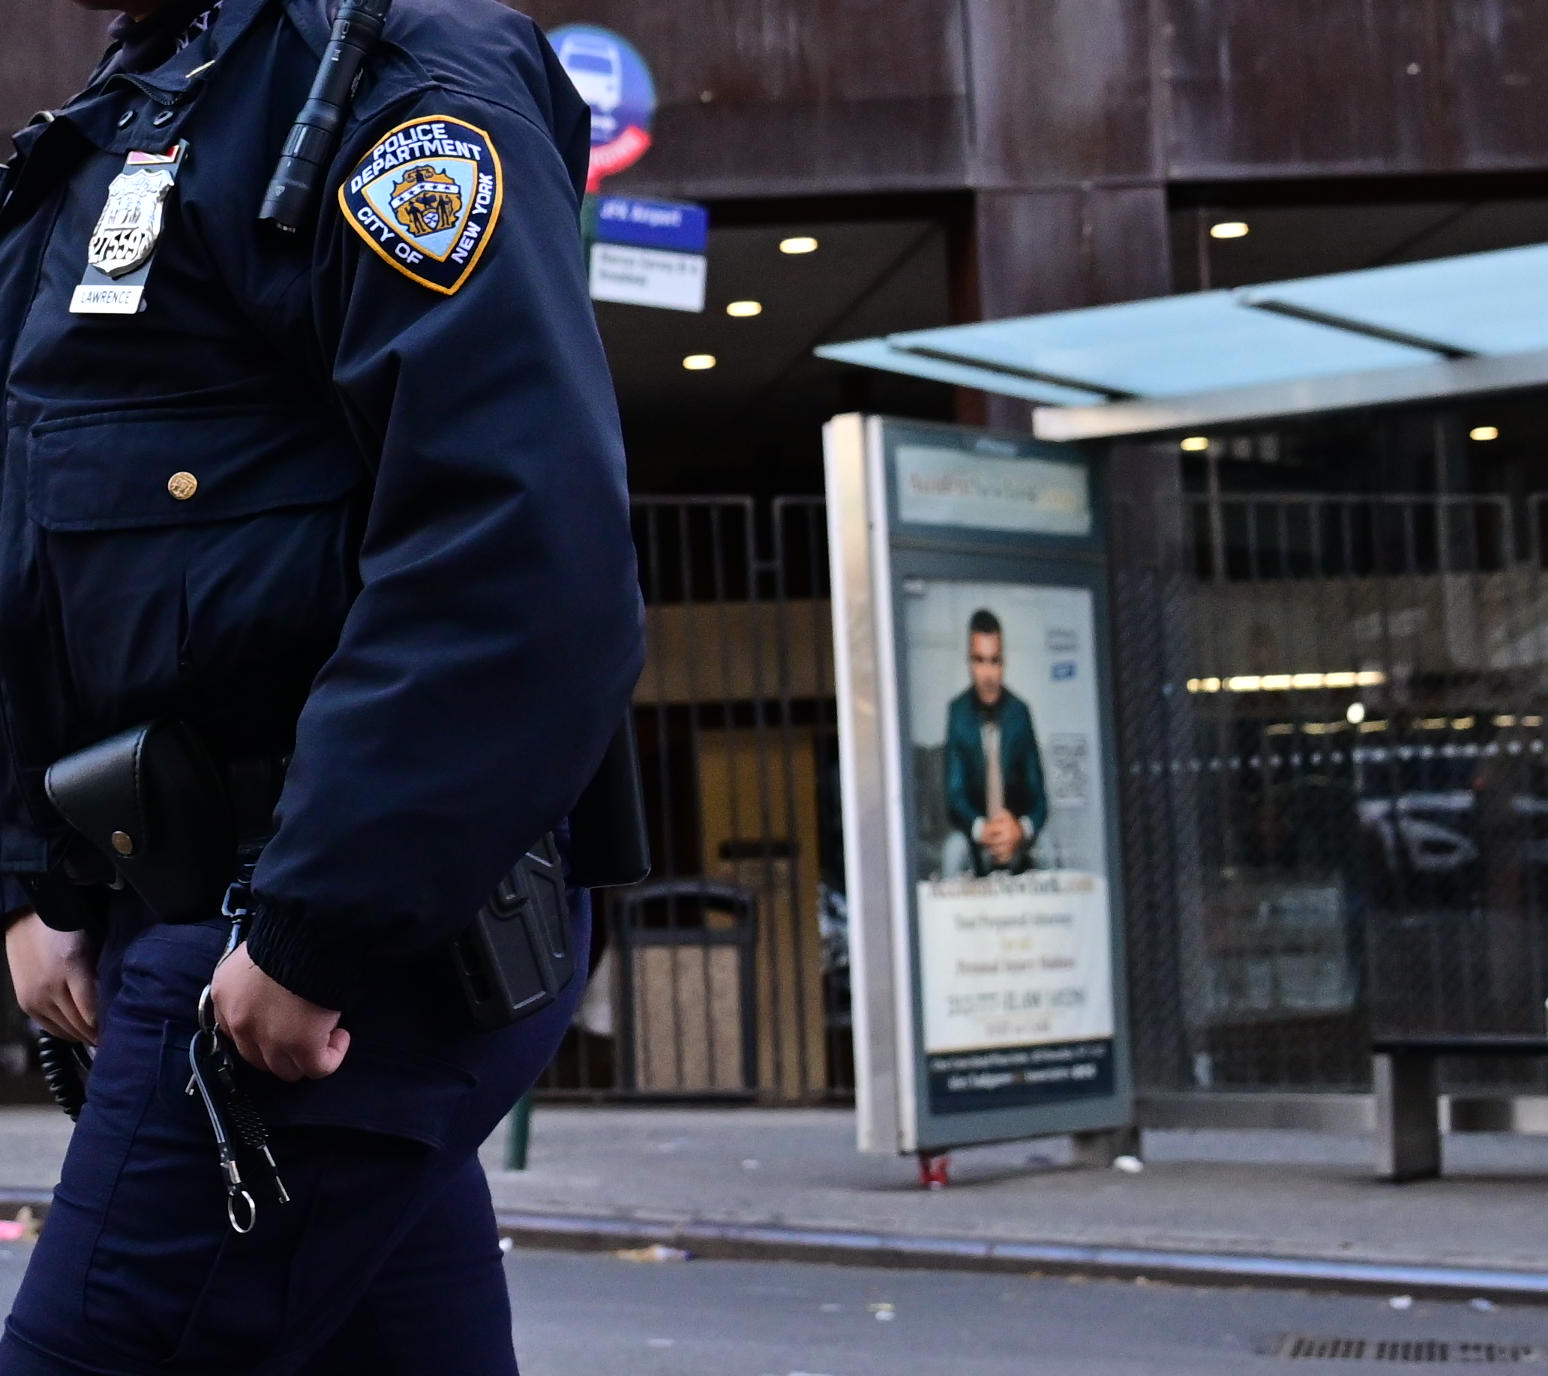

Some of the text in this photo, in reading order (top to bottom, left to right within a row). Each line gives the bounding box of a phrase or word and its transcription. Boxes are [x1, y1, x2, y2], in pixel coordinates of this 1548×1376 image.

[372, 123, 449, 161] POLICE
[350, 139, 482, 195] DEPARTMENT
[357, 173, 494, 265] CITY OF NEW YORK
[80, 290, 133, 305] LAWRENCE
